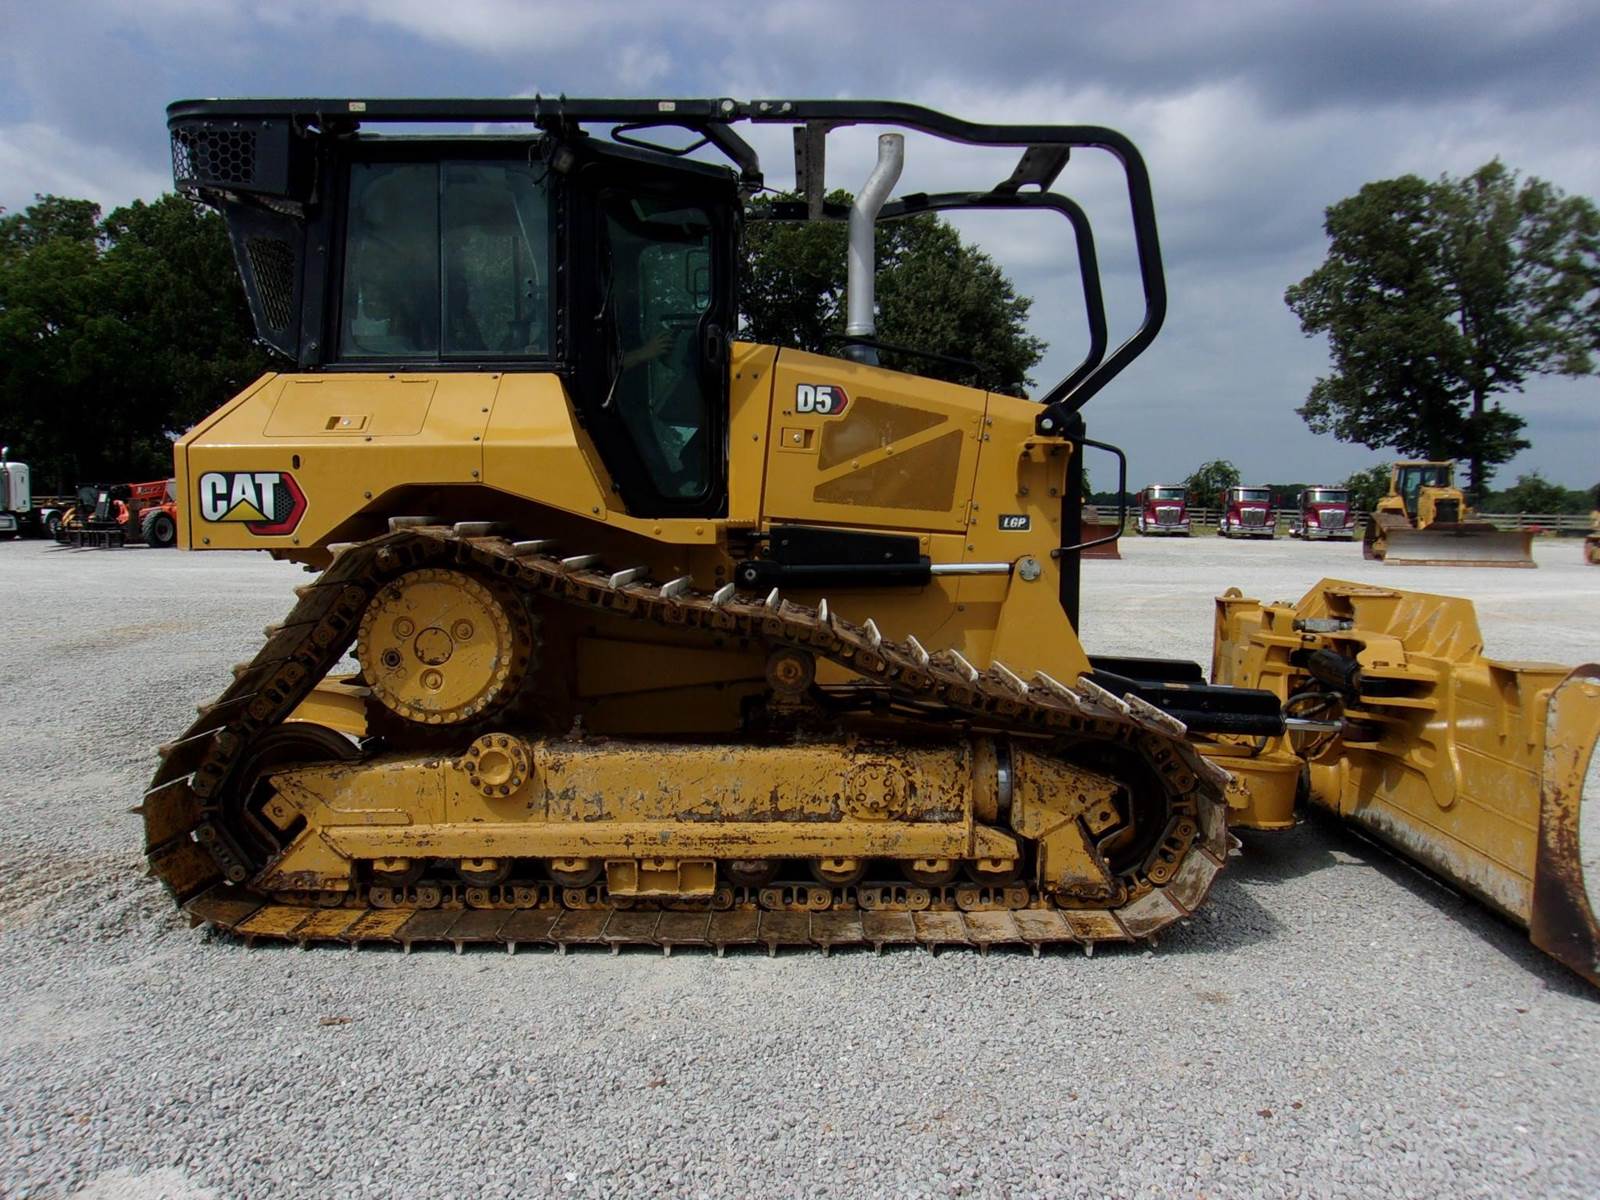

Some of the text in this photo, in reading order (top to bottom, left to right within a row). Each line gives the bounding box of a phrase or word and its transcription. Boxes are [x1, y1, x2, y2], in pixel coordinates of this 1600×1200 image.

[797, 384, 832, 413] D5
[200, 472, 280, 521] CAT
[1003, 516, 1027, 528] LGP
